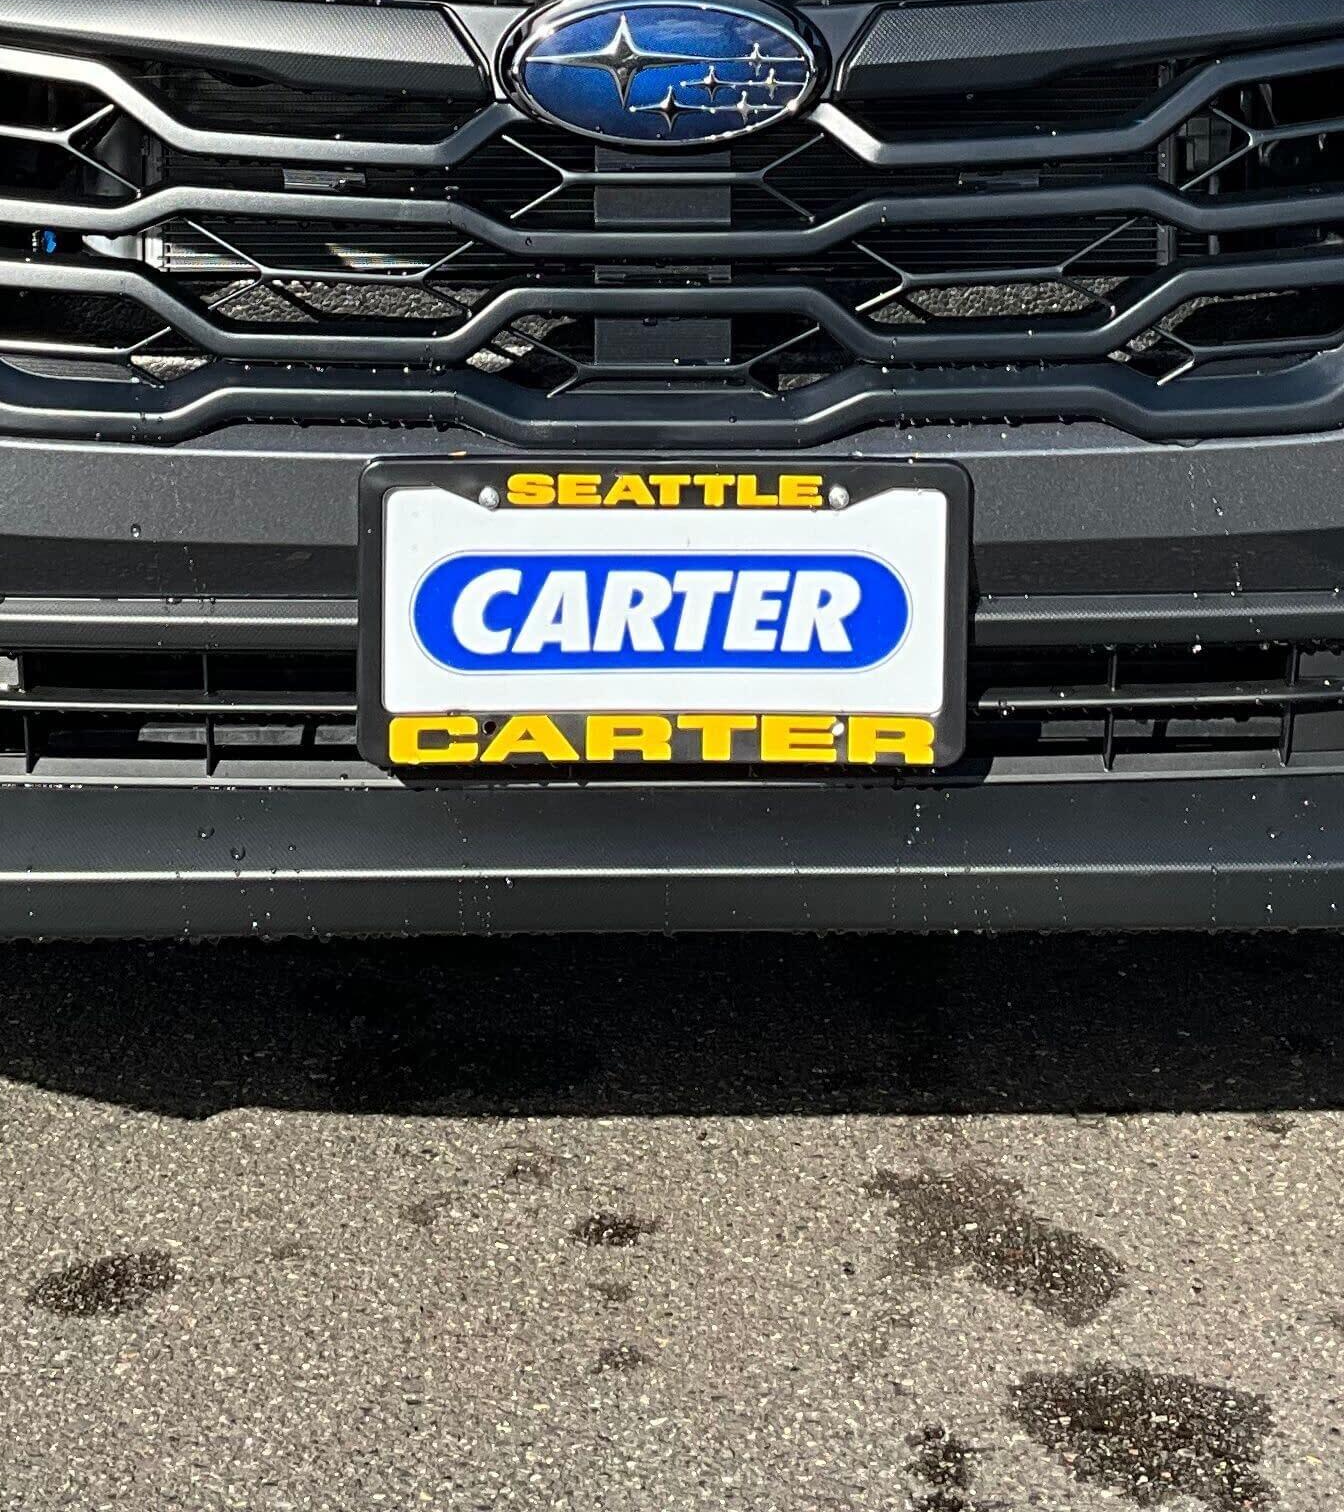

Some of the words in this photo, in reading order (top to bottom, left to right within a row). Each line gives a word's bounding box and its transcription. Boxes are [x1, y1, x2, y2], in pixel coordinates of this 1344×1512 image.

[506, 473, 823, 507] SEATTLE
[451, 568, 862, 654] CARTER
[388, 714, 935, 765] CARTER
